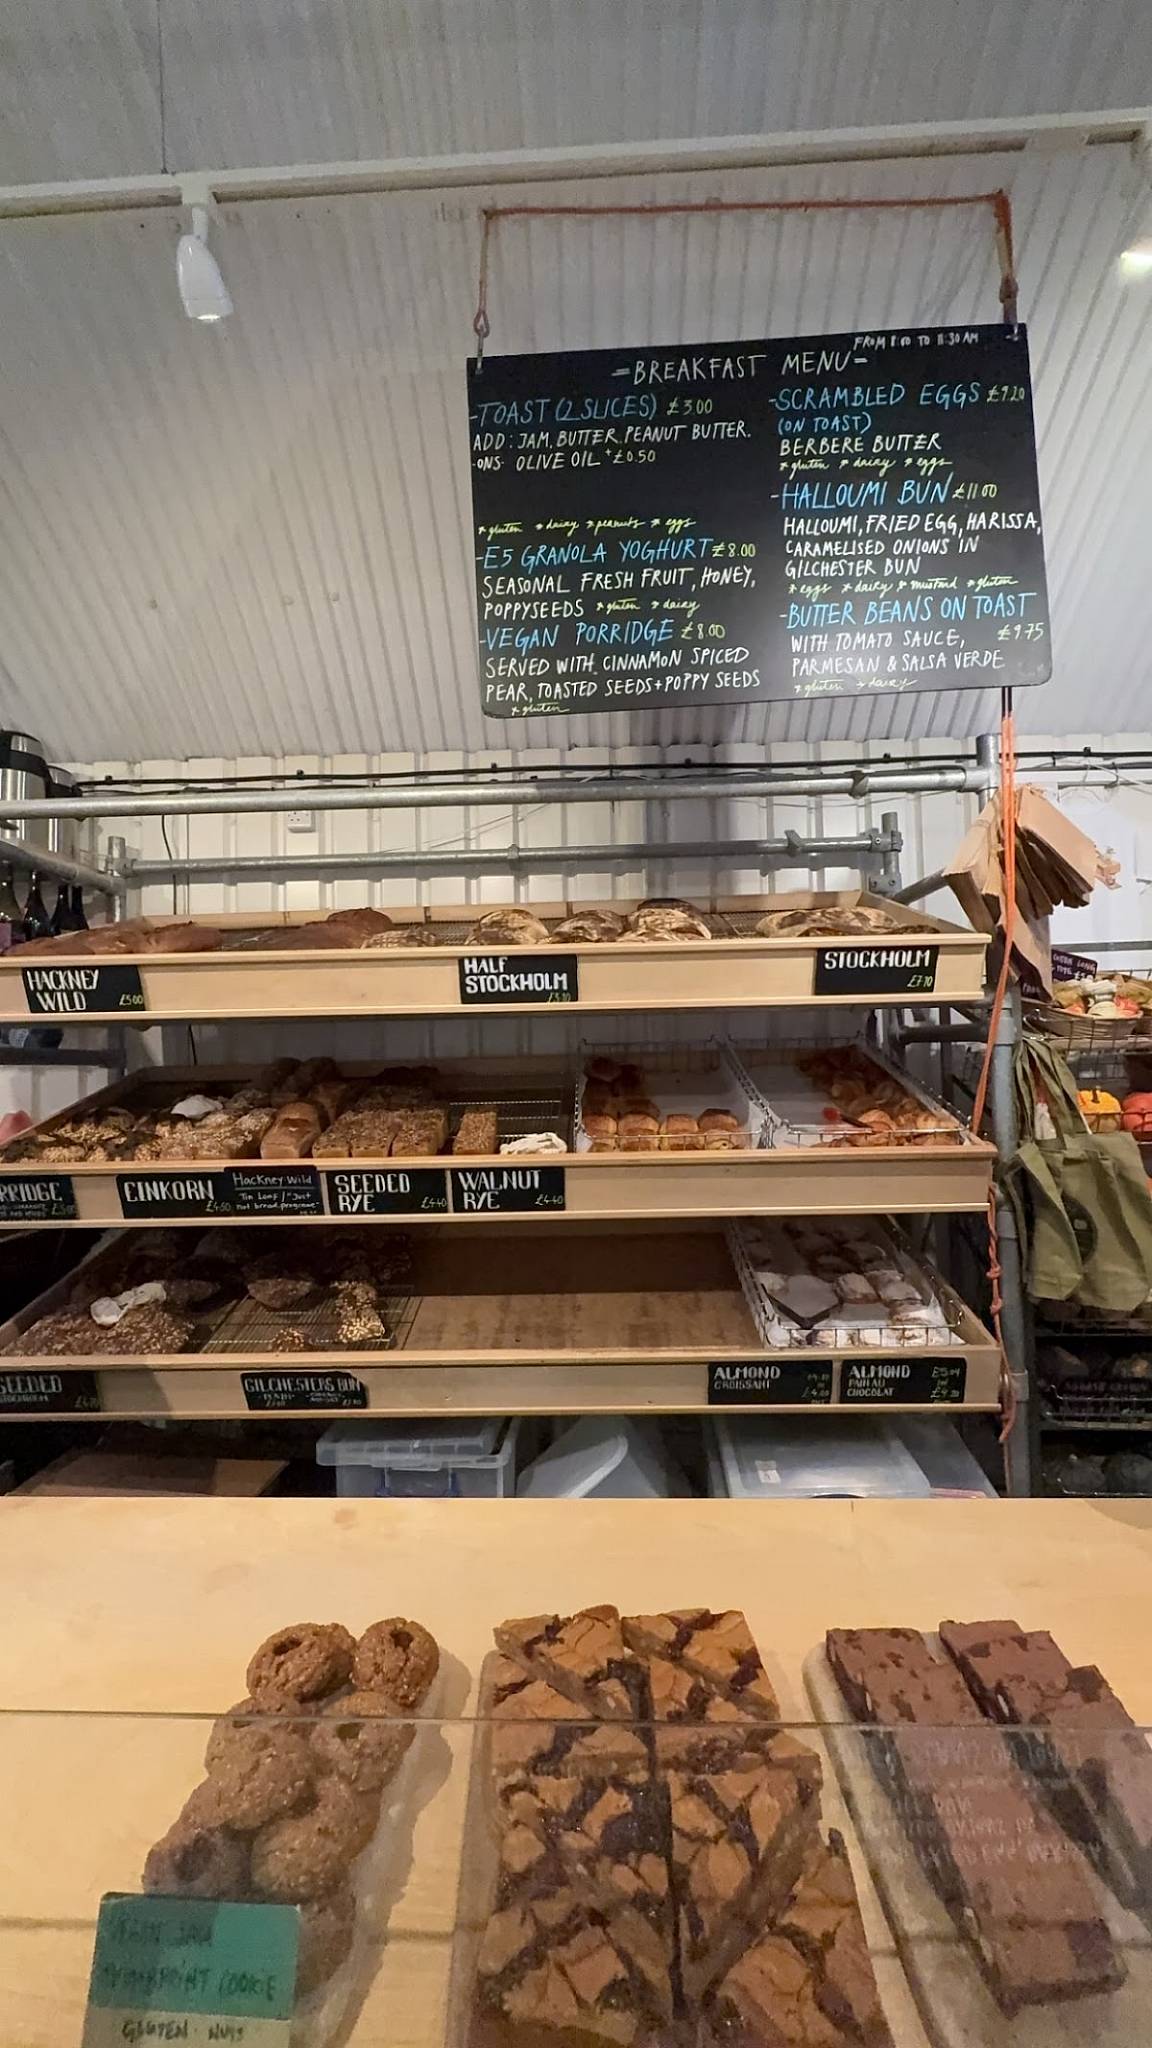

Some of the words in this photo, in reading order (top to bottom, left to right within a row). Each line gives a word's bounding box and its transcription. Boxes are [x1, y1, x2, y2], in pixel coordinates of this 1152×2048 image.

[853, 335, 886, 350] FROM
[917, 335, 930, 347] TO
[962, 332, 979, 344] AM
[633, 354, 768, 385] BREAKFAST
[781, 350, 851, 375] MENU
[919, 382, 980, 410] EGGS
[624, 425, 687, 444] PEANUT
[777, 417, 805, 435] (ON
[813, 411, 871, 434] TOAST)
[780, 437, 864, 456] BERBERE
[872, 432, 942, 453] BUTTER
[516, 452, 565, 471] OLIVE
[571, 450, 601, 467] OIL
[791, 459, 830, 480] gluten
[853, 457, 896, 478] dairy
[897, 471, 953, 505] BUN
[488, 522, 523, 541] gluten
[545, 518, 579, 537] dairy
[665, 517, 696, 534] eggs
[783, 514, 862, 537] HALLOUMI,
[865, 513, 921, 534] FRIED
[924, 512, 963, 539] EGG,
[966, 511, 1041, 535] HARISSA,
[521, 542, 607, 574] GRANOLA
[619, 537, 714, 564] YOGHURT
[711, 541, 756, 557] £8.00
[785, 539, 885, 557] CARAMELISED
[892, 537, 950, 555] ONIONS
[958, 534, 980, 553] IN
[785, 558, 877, 580] GILCHESTER
[883, 556, 921, 577] BUN
[481, 574, 571, 599] SEASONAL
[580, 571, 634, 592] FRESH
[700, 564, 756, 588] HONEY,
[800, 582, 832, 602] eggs
[854, 579, 894, 599] dairy
[910, 575, 958, 590] mustard
[484, 599, 584, 620] POPPYSEEDS
[606, 598, 641, 615] gluten
[663, 598, 700, 618] dairy
[864, 594, 934, 626] BEANS
[940, 594, 967, 620] ON
[972, 591, 1037, 619] TOAST
[575, 618, 675, 647] PORRIDGE
[791, 633, 829, 654] WITH
[835, 631, 893, 652] TOMATO
[903, 628, 965, 649] SAUCE,
[486, 657, 550, 679] SERVED
[602, 649, 682, 672] CINNAMON
[690, 646, 750, 665] SPICED
[792, 655, 880, 678] PARMESAN
[886, 655, 897, 673] &
[902, 651, 947, 673] SALSA
[954, 649, 1006, 669] VERDE
[486, 682, 533, 703] PEAR,
[537, 680, 598, 700] TOASTED
[714, 669, 760, 688] SEEDS
[804, 679, 844, 698] gluten
[521, 701, 570, 716] gluten
[463, 957, 508, 974] HALF
[824, 949, 931, 969] STOCKHOLM
[27, 969, 99, 991] HACKNEY
[465, 972, 568, 994] STOCKHOLM
[36, 991, 87, 1012] WILD
[124, 1179, 214, 1202] EINKORN
[334, 1173, 410, 1194] SEEDED
[458, 1169, 542, 1191] WALNUT
[338, 1194, 375, 1213] RYE
[463, 1190, 500, 1210] RYE
[714, 1365, 781, 1380] ALMOND
[848, 1364, 911, 1379] ALMOND
[714, 1379, 770, 1390] CROISSANT
[846, 1387, 896, 1397] CHOCOLAT
[121, 2019, 188, 2043] GLUTEN
